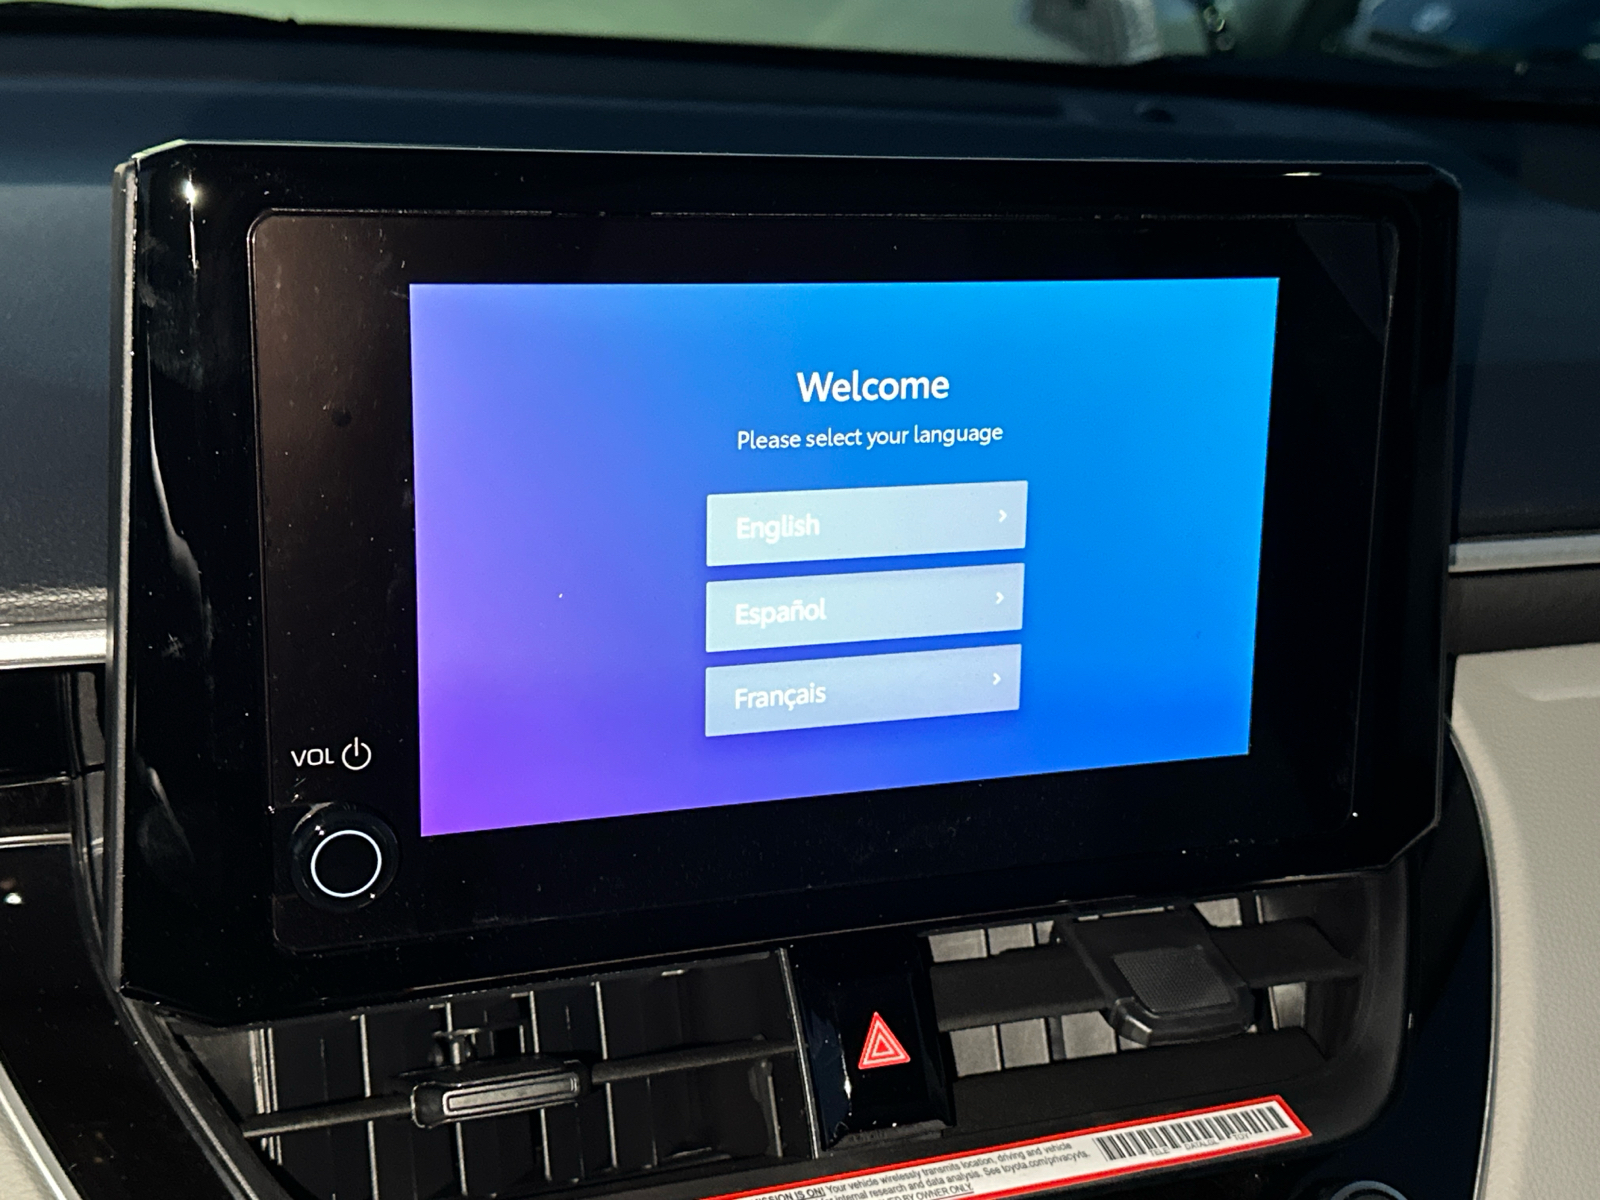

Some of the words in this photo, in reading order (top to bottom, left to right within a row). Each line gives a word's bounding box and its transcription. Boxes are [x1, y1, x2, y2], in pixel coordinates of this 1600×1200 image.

[796, 369, 950, 402] Welcome
[737, 430, 801, 450] Please
[805, 427, 862, 448] select
[866, 428, 909, 449] your
[913, 424, 1003, 446] language
[736, 513, 820, 544] English
[735, 597, 827, 629] Español
[734, 682, 826, 710] Français
[290, 748, 335, 767] VOL
[794, 1190, 805, 1200] IS
[825, 1184, 847, 1194] Your
[848, 1178, 879, 1189] vehicle
[880, 1170, 921, 1184] wirelessly
[921, 1163, 960, 1176] transmits
[997, 1151, 1026, 1161] driving
[1026, 1146, 1042, 1157] and
[1043, 1142, 1072, 1153] vehicle
[869, 1183, 907, 1197] research
[908, 1180, 925, 1190] and
[925, 1177, 945, 1187] data
[983, 1167, 1000, 1176] See
[916, 1187, 949, 1200] OWNER
